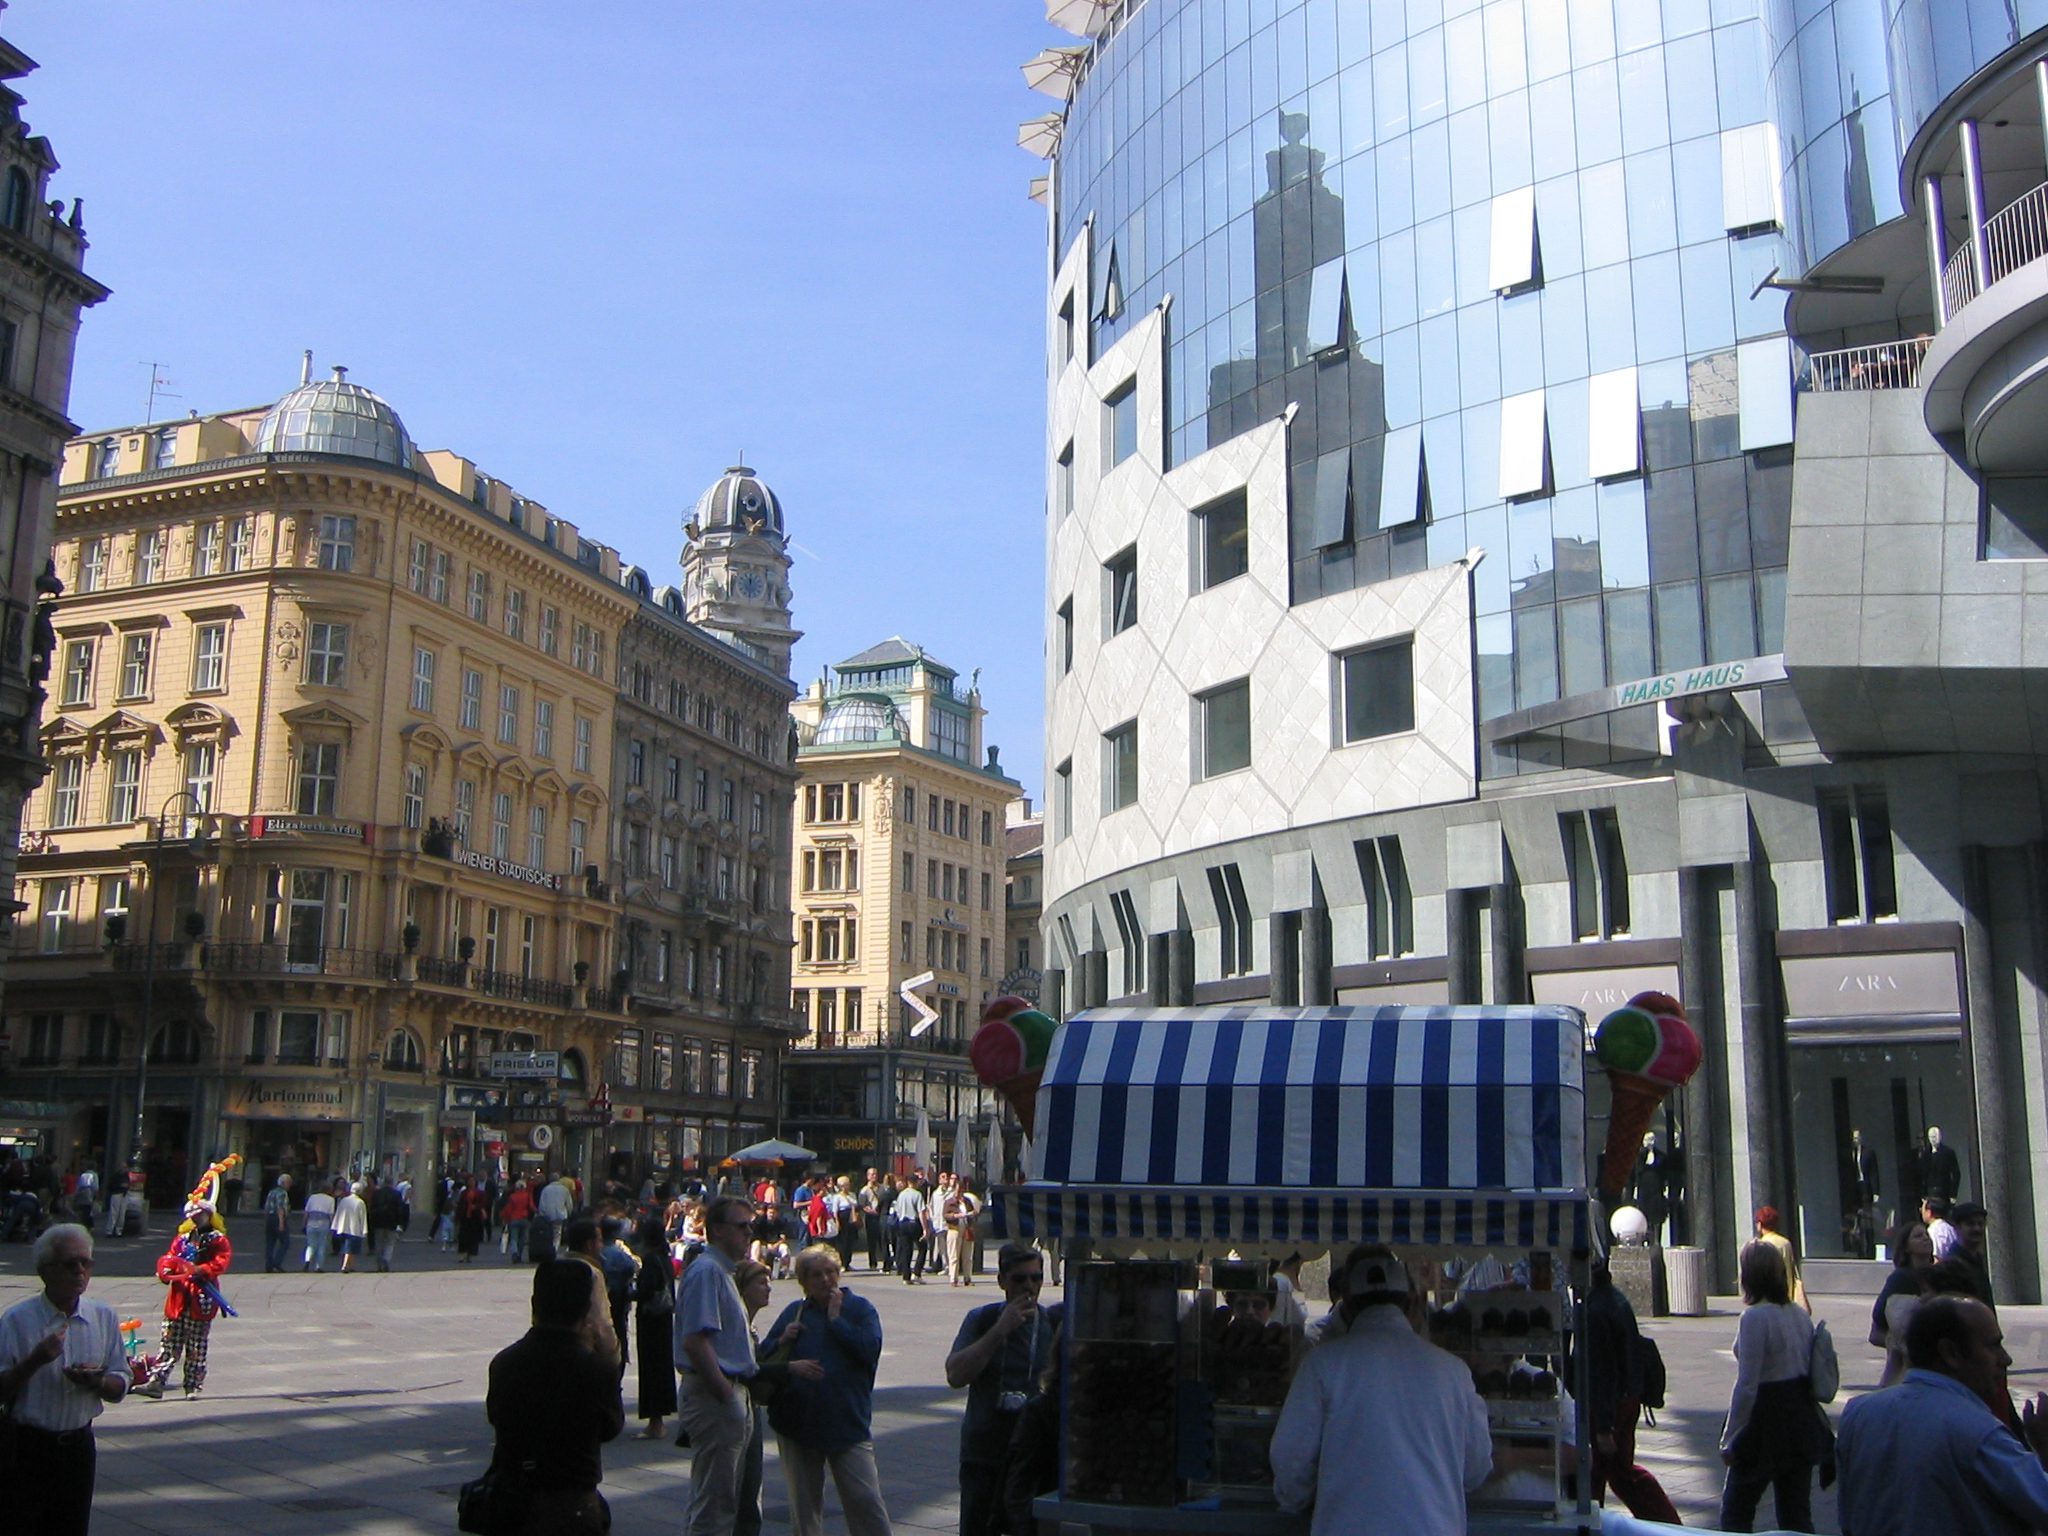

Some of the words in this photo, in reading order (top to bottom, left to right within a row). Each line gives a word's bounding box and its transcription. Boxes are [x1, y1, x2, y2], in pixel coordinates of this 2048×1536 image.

[1621, 677, 1676, 705] HAAS
[1684, 664, 1745, 692] HAUS
[267, 819, 326, 832] Elizabeth
[331, 823, 363, 836] Arden
[457, 849, 496, 873] WIENER
[1837, 975, 1897, 991] ZARA
[1580, 988, 1630, 1005] ZARA
[494, 1059, 555, 1069] FRISEUR
[235, 1080, 343, 1109] Marionnaud
[513, 1107, 557, 1121] ZEISS
[834, 1136, 875, 1151] SCHÖPS
